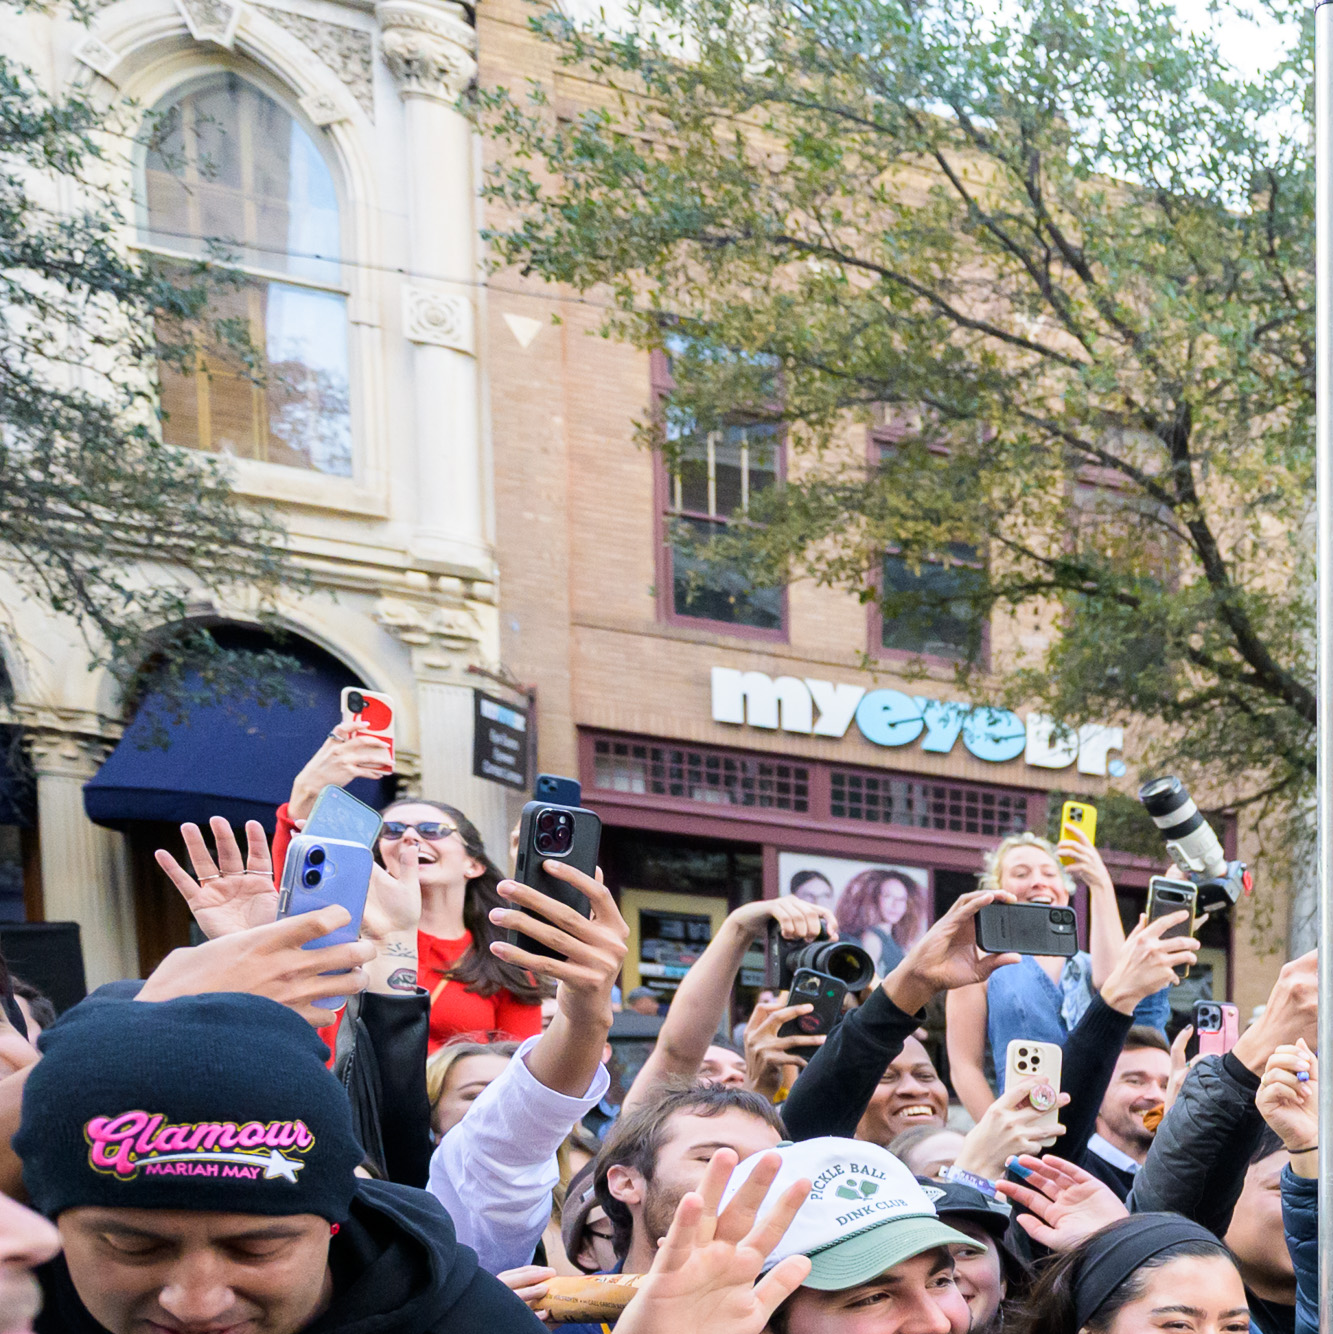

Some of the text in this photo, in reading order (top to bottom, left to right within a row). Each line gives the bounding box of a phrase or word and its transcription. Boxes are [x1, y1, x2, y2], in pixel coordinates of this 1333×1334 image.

[86, 1110, 315, 1176] Glamour
[145, 1162, 261, 1179] MARIAH MAY
[810, 1162, 887, 1200] PICKLE BALL
[835, 1198, 909, 1227] DINK CLUB
